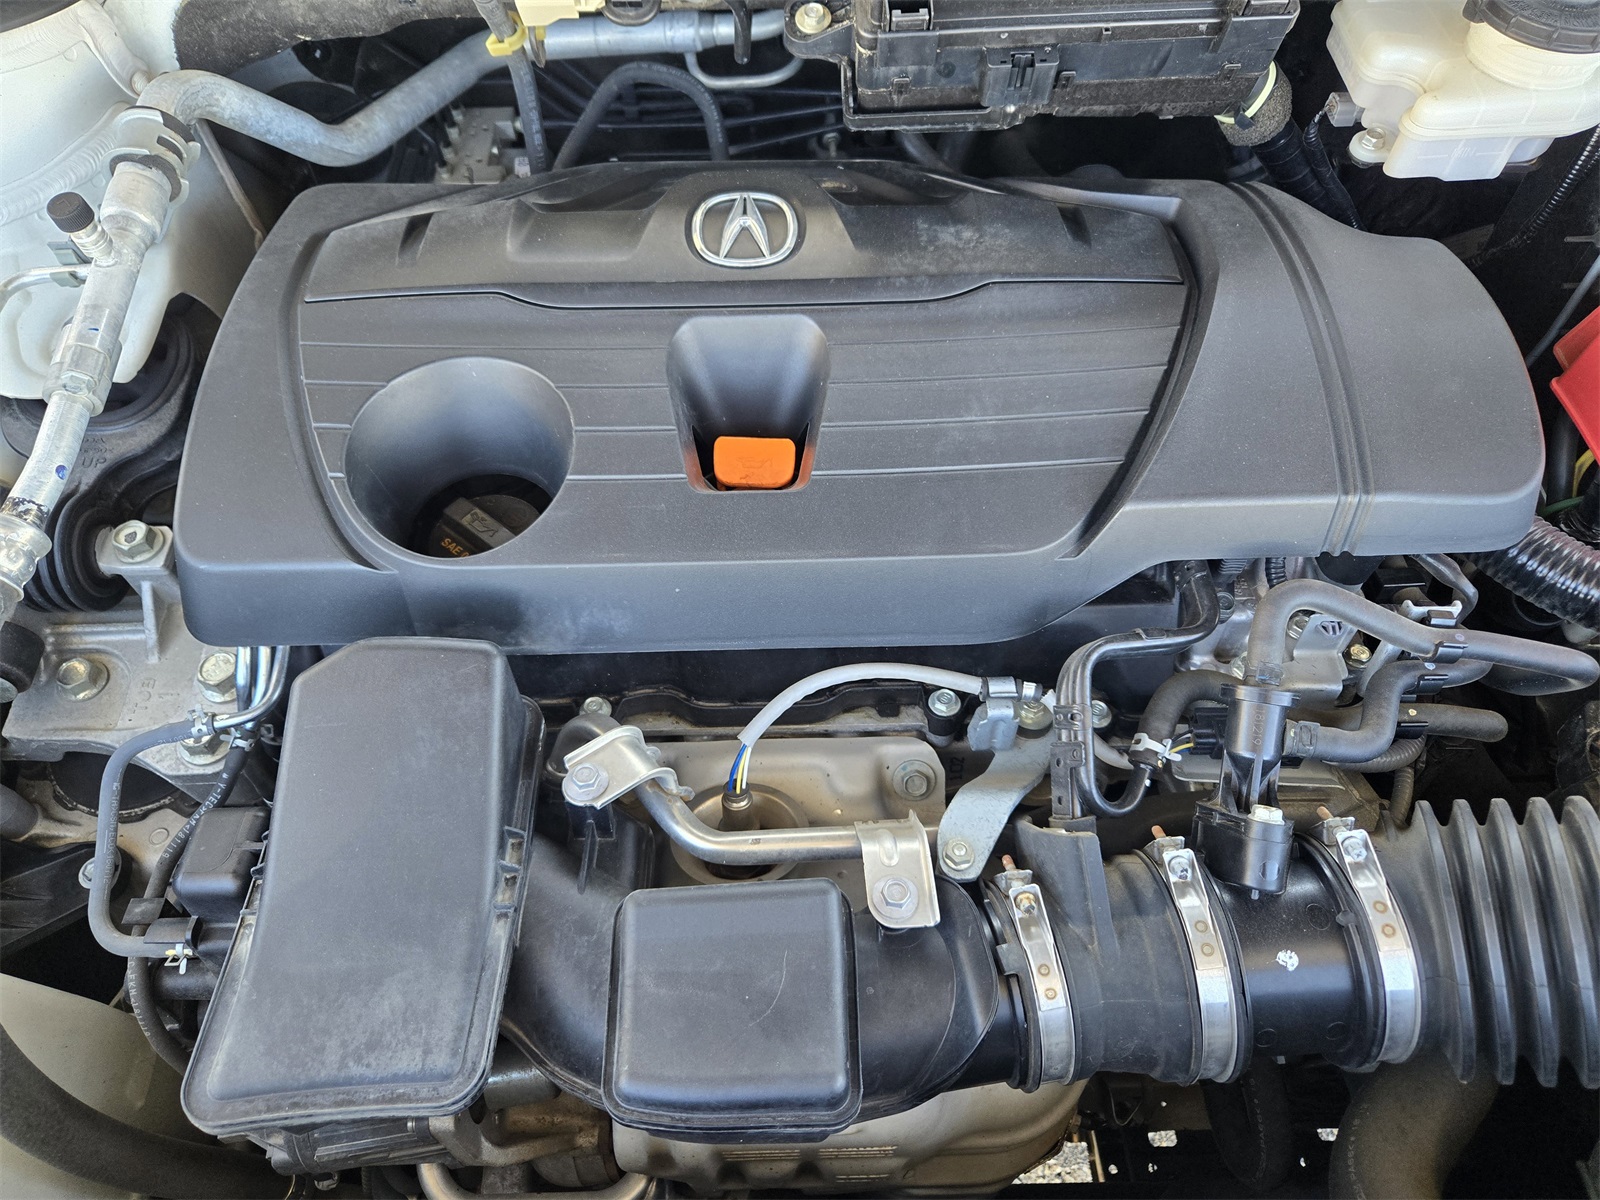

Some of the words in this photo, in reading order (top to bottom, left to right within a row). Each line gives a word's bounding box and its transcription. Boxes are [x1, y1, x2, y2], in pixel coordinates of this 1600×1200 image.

[82, 457, 107, 469] UP
[441, 537, 463, 556] SAE
[1251, 709, 1266, 746] 181219
